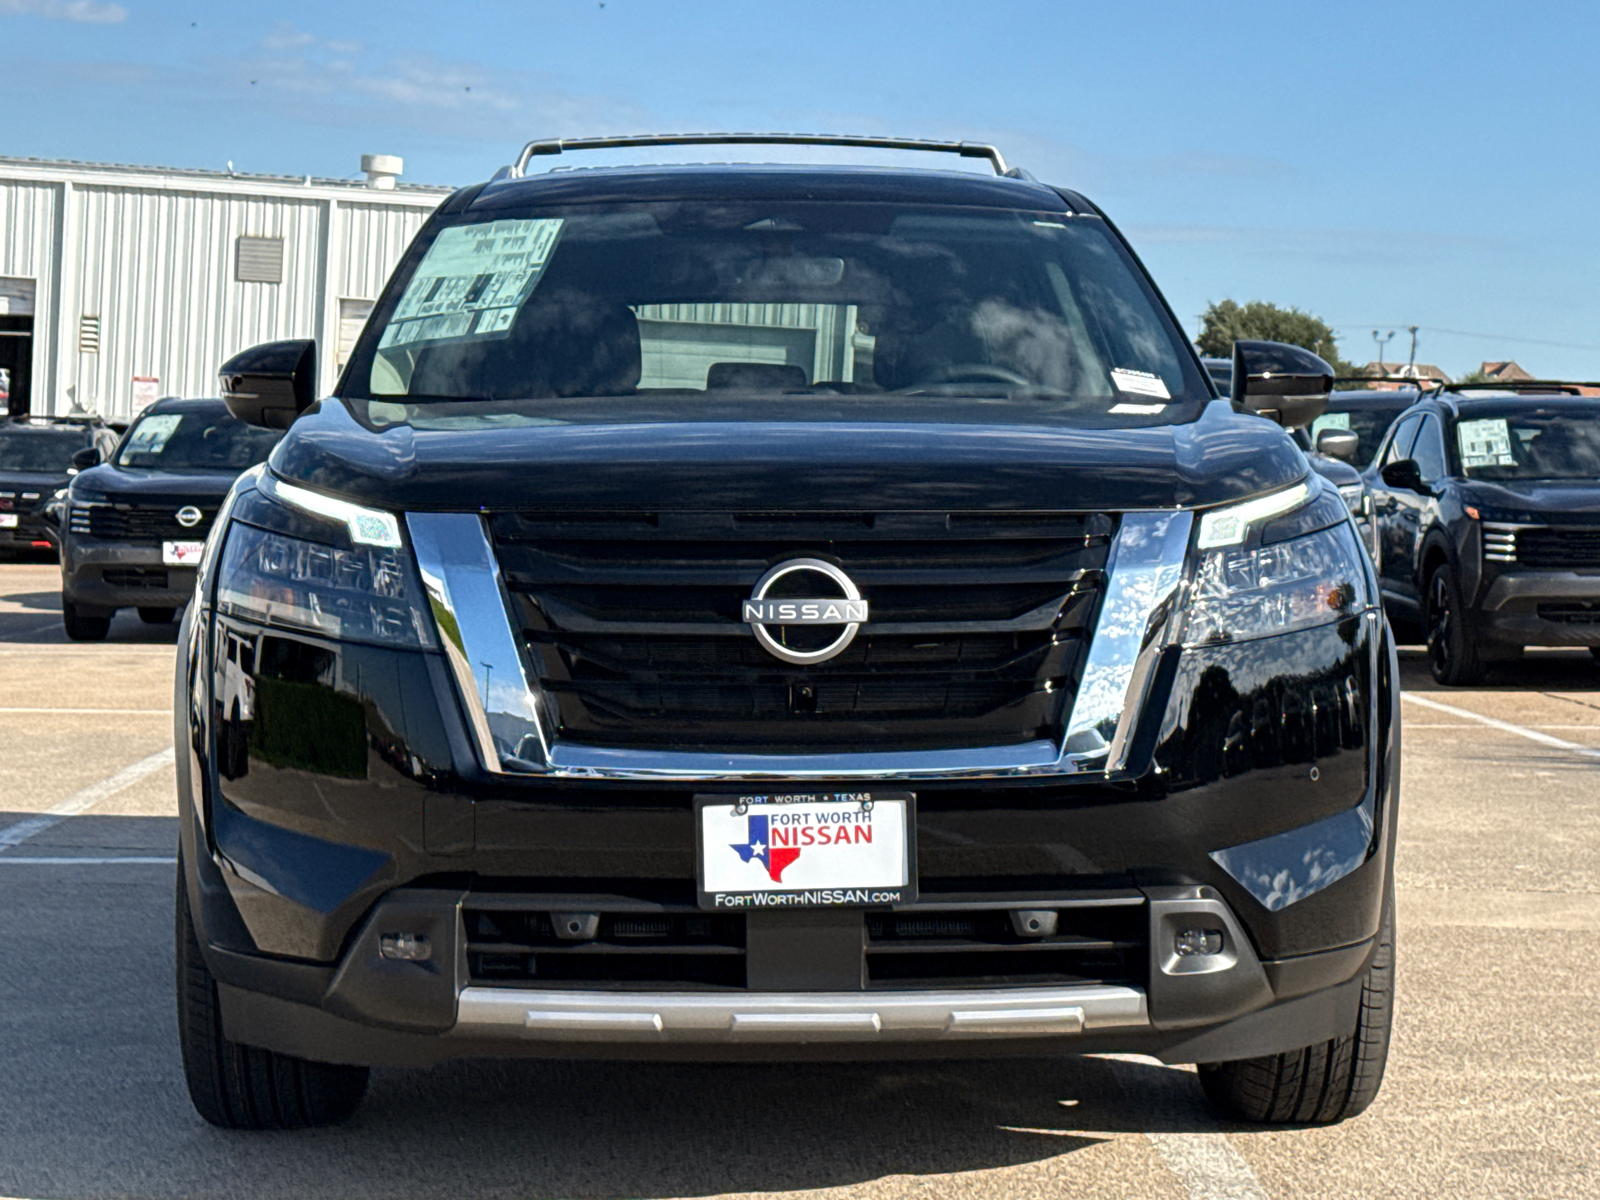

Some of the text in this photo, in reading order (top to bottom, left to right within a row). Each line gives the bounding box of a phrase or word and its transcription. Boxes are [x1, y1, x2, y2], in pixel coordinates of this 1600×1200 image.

[745, 604, 863, 619] NISSAN
[739, 793, 871, 804] FORT WORTH TEXAS
[771, 812, 872, 825] FORT WORTH
[771, 825, 872, 846] NISSAN
